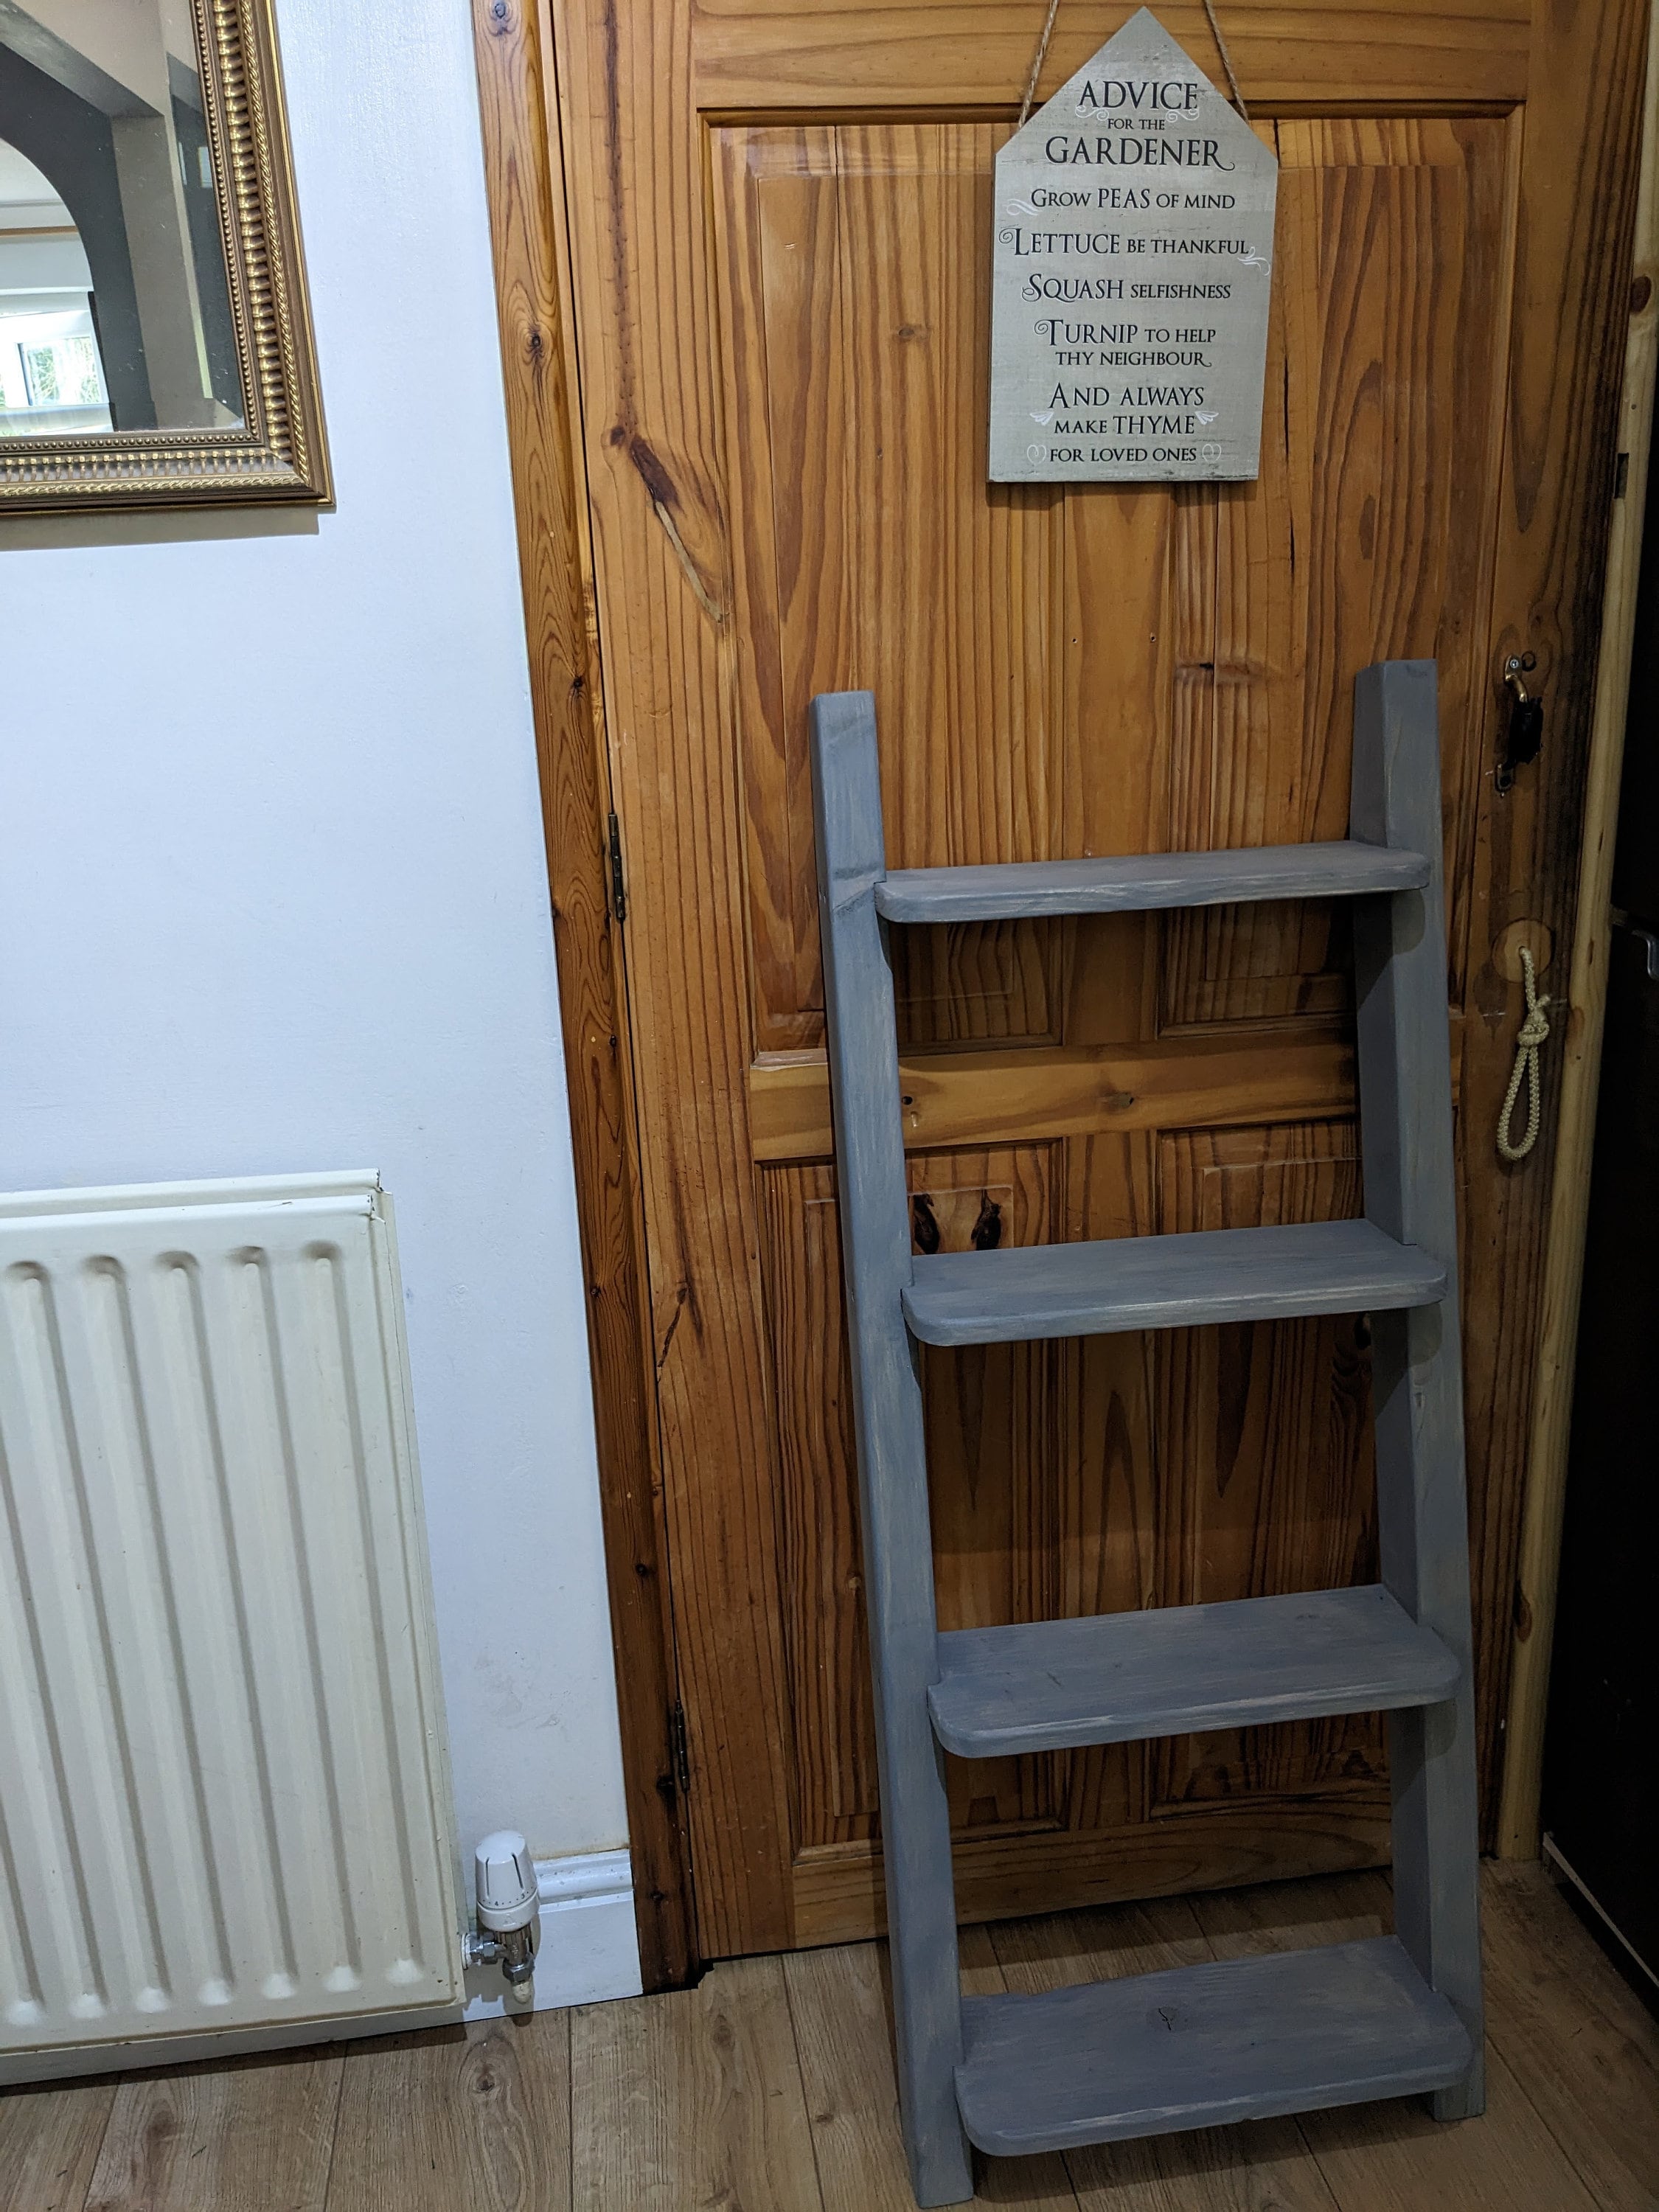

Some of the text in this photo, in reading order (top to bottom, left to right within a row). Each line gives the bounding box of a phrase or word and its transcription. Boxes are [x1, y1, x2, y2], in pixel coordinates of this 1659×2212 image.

[1078, 80, 1198, 110] ADVICE
[1107, 118, 1165, 131] FOR THE
[1045, 136, 1236, 171] GARDENER
[1032, 189, 1236, 209] GROW PEAS OF MIND
[998, 227, 1249, 256] LETTUCE BE THANKFUL
[1022, 274, 1231, 302] SQUASH SELFISHNESS
[1034, 319, 1217, 346] TURNIP TO HELP
[1055, 352, 1212, 367] THY NEIGHBOUR
[1048, 382, 1205, 409] AND ALWAYS
[1054, 416, 1195, 434] MAKE THYME
[1050, 448, 1197, 462] FOR LOVED ONES
